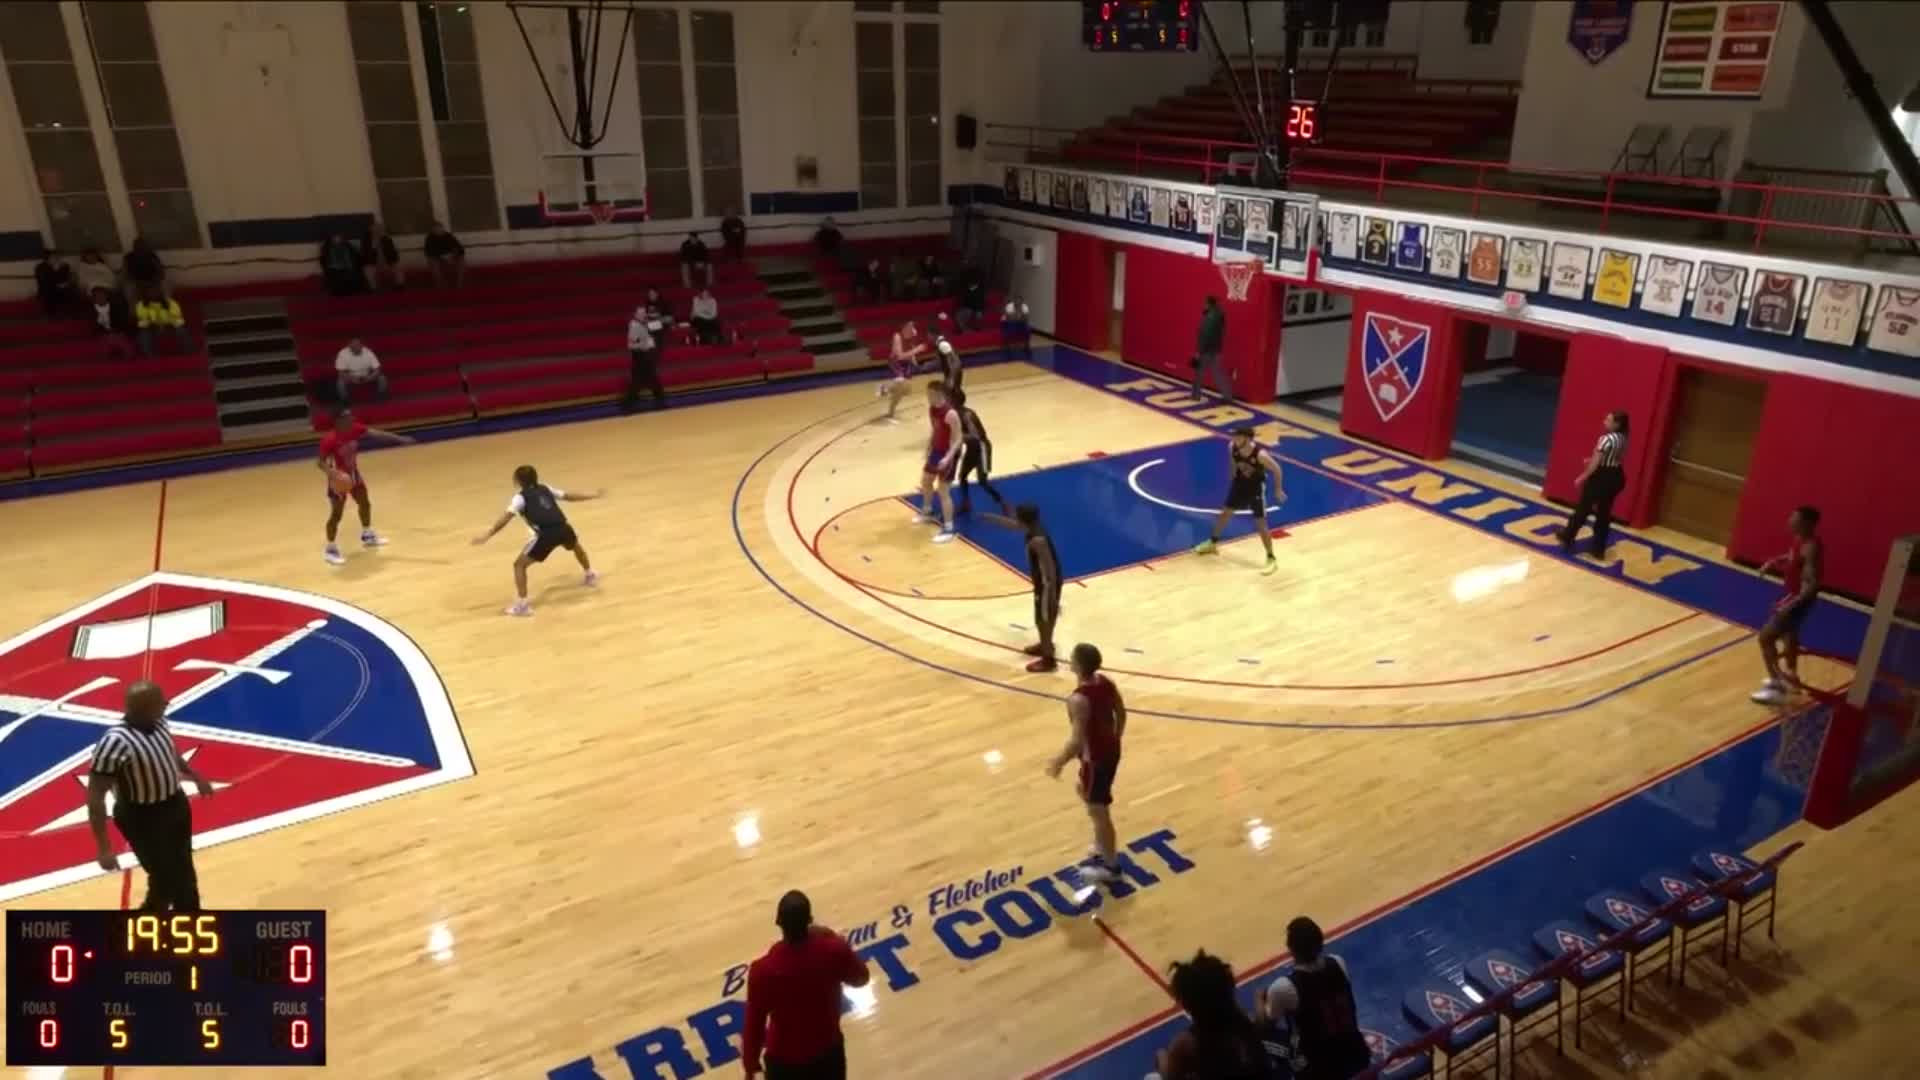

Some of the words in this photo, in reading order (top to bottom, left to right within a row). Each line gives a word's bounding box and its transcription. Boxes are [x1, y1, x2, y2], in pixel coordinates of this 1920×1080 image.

[1287, 105, 1315, 138] 26
[1104, 377, 1320, 447] FORK
[1321, 449, 1704, 585] UNION
[928, 865, 1024, 916] Fletcher
